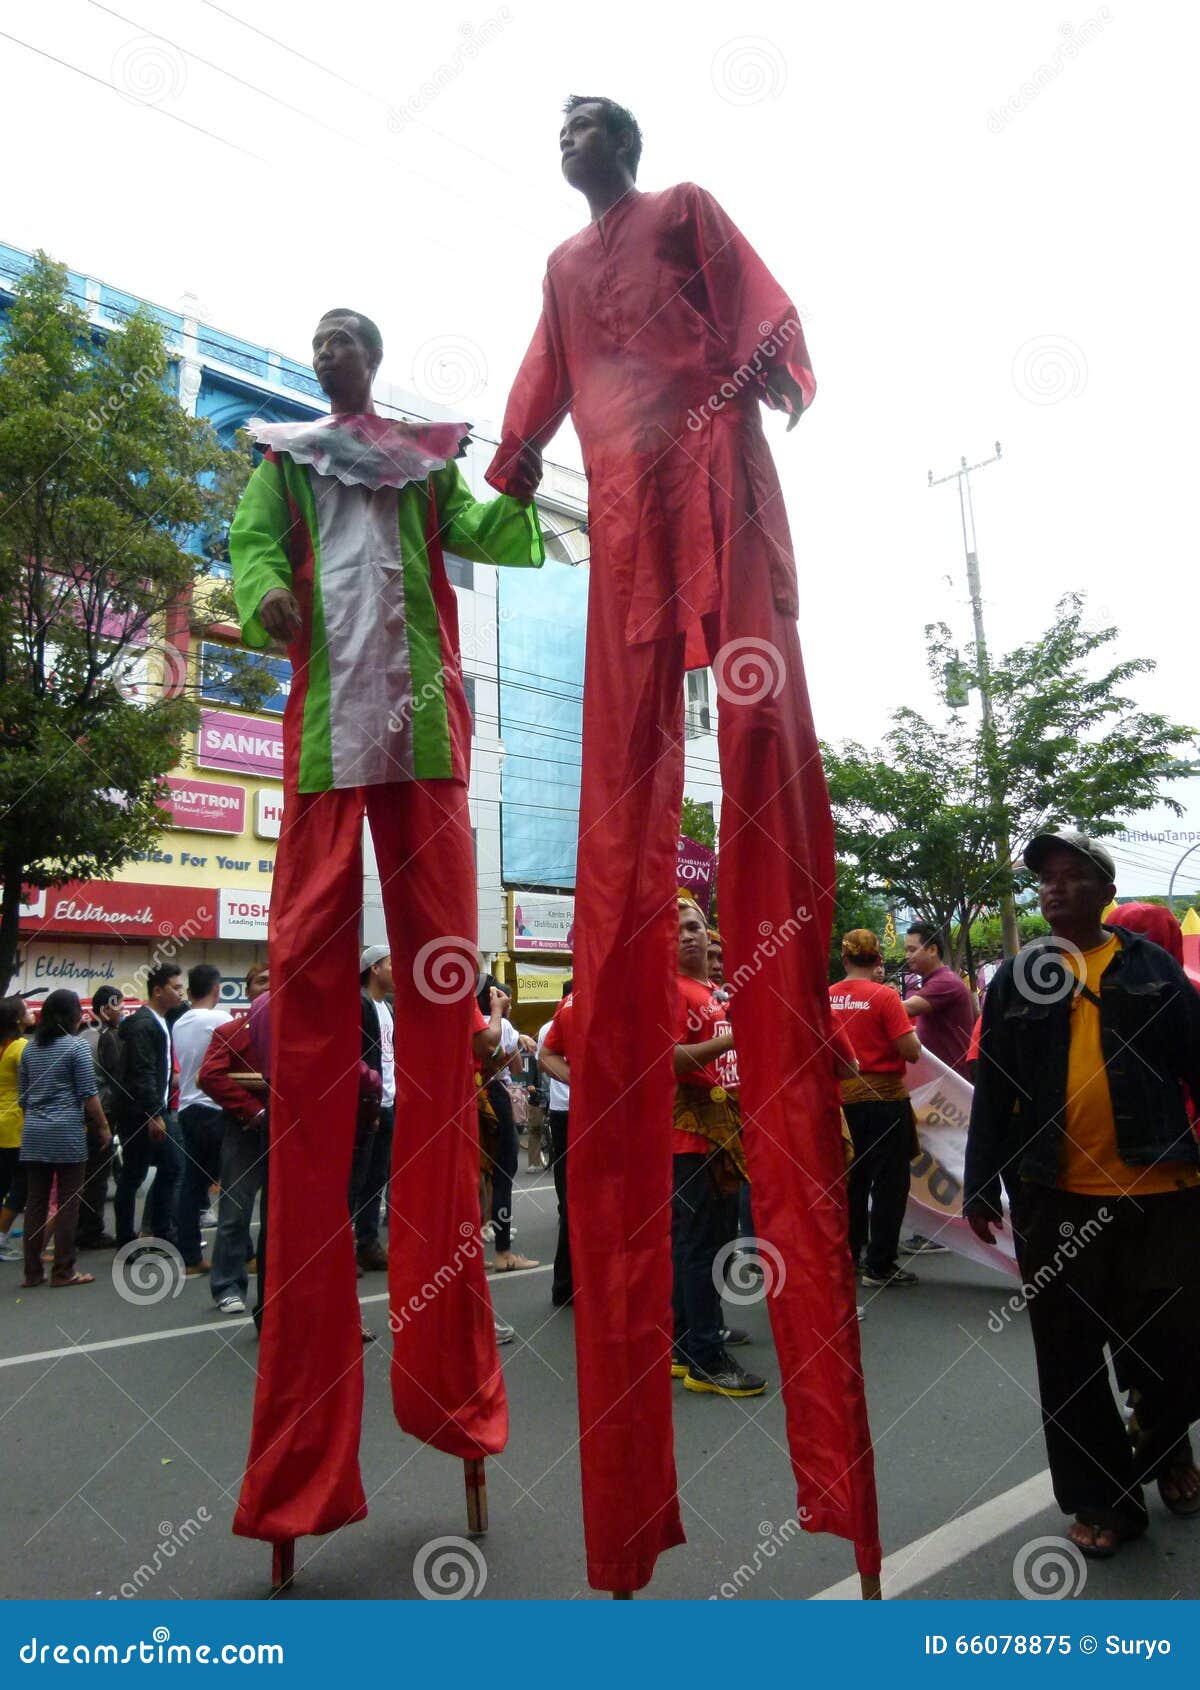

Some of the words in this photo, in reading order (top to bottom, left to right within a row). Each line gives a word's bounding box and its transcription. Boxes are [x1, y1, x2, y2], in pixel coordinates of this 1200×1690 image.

[181, 852, 207, 868] For
[216, 856, 251, 872] Your
[54, 900, 153, 924] Elektronik
[228, 918, 254, 928] Leading
[35, 955, 115, 979] Elektronik
[518, 978, 549, 989] Disewa
[844, 994, 870, 1010] home
